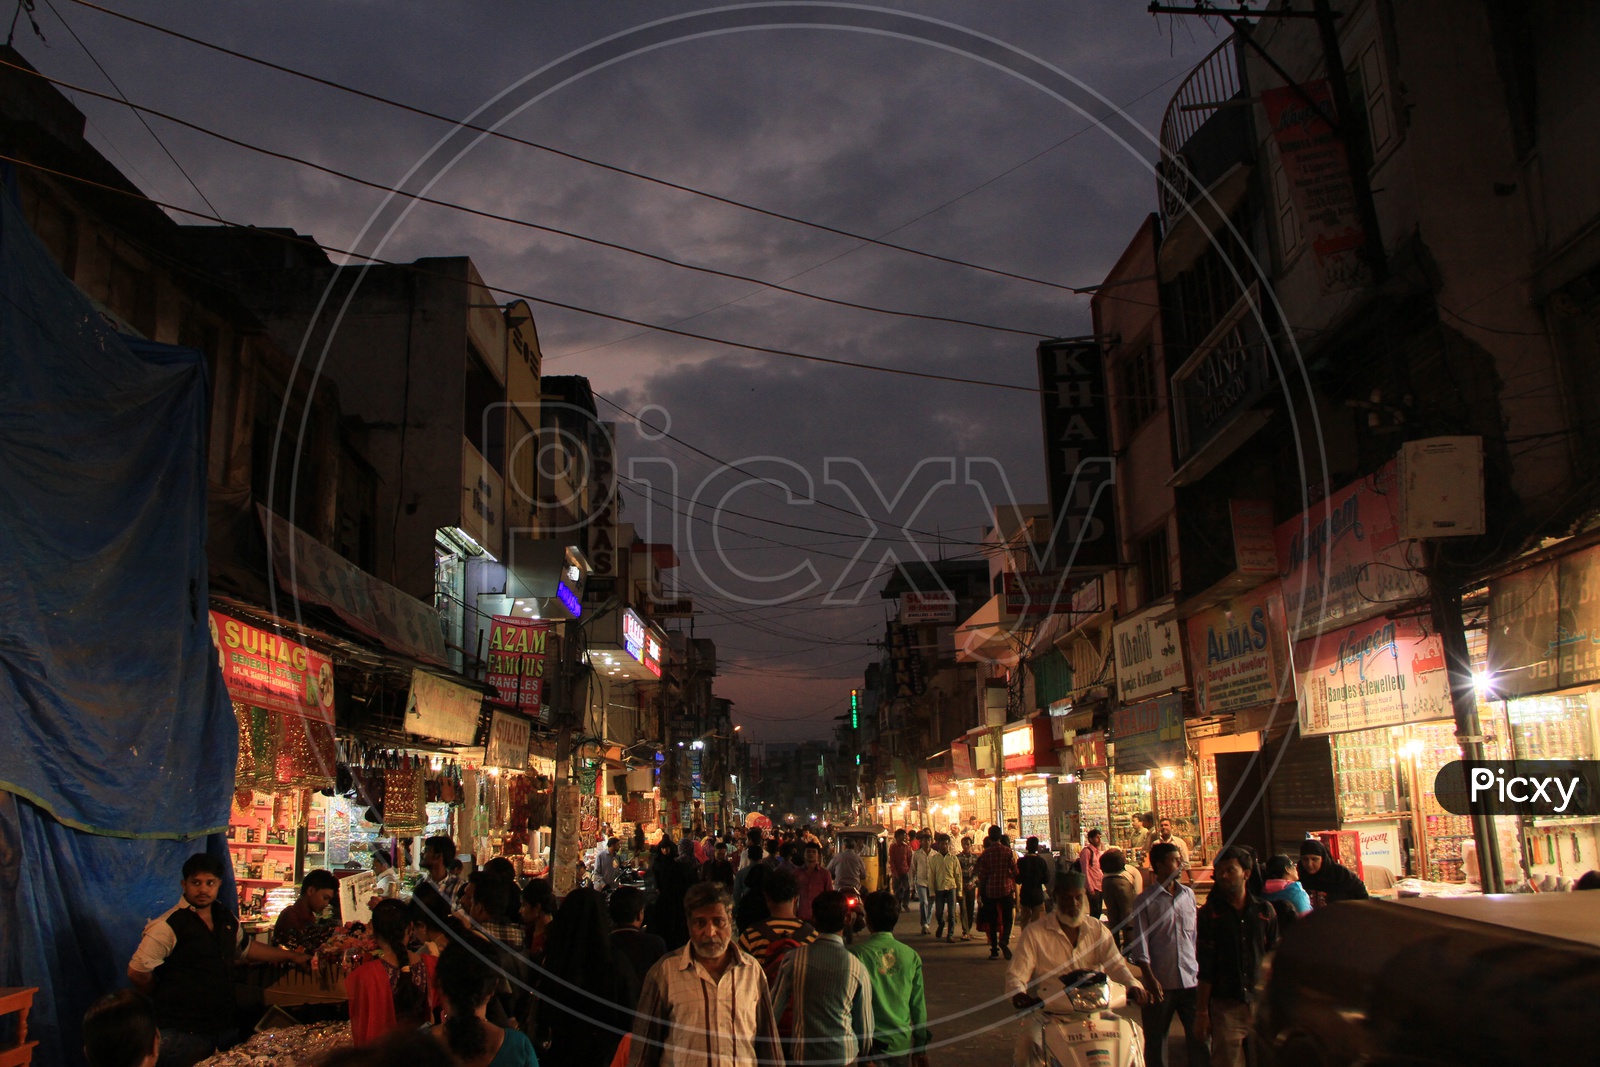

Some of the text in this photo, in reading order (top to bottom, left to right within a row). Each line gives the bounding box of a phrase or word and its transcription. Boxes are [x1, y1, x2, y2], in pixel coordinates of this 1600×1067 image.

[1273, 100, 1332, 134] Nayem
[1052, 348, 1105, 544] KHALID
[225, 620, 307, 672] SUHAG
[490, 626, 547, 654] AZAM
[1207, 606, 1267, 667] ALMAS
[1329, 621, 1399, 681] Nayeem
[230, 651, 273, 675] GENERAL
[275, 666, 302, 683] STORE
[487, 654, 544, 678] FAMOUS
[1328, 674, 1406, 702] Bangles & Jewellery
[1111, 701, 1159, 740] KHALID
